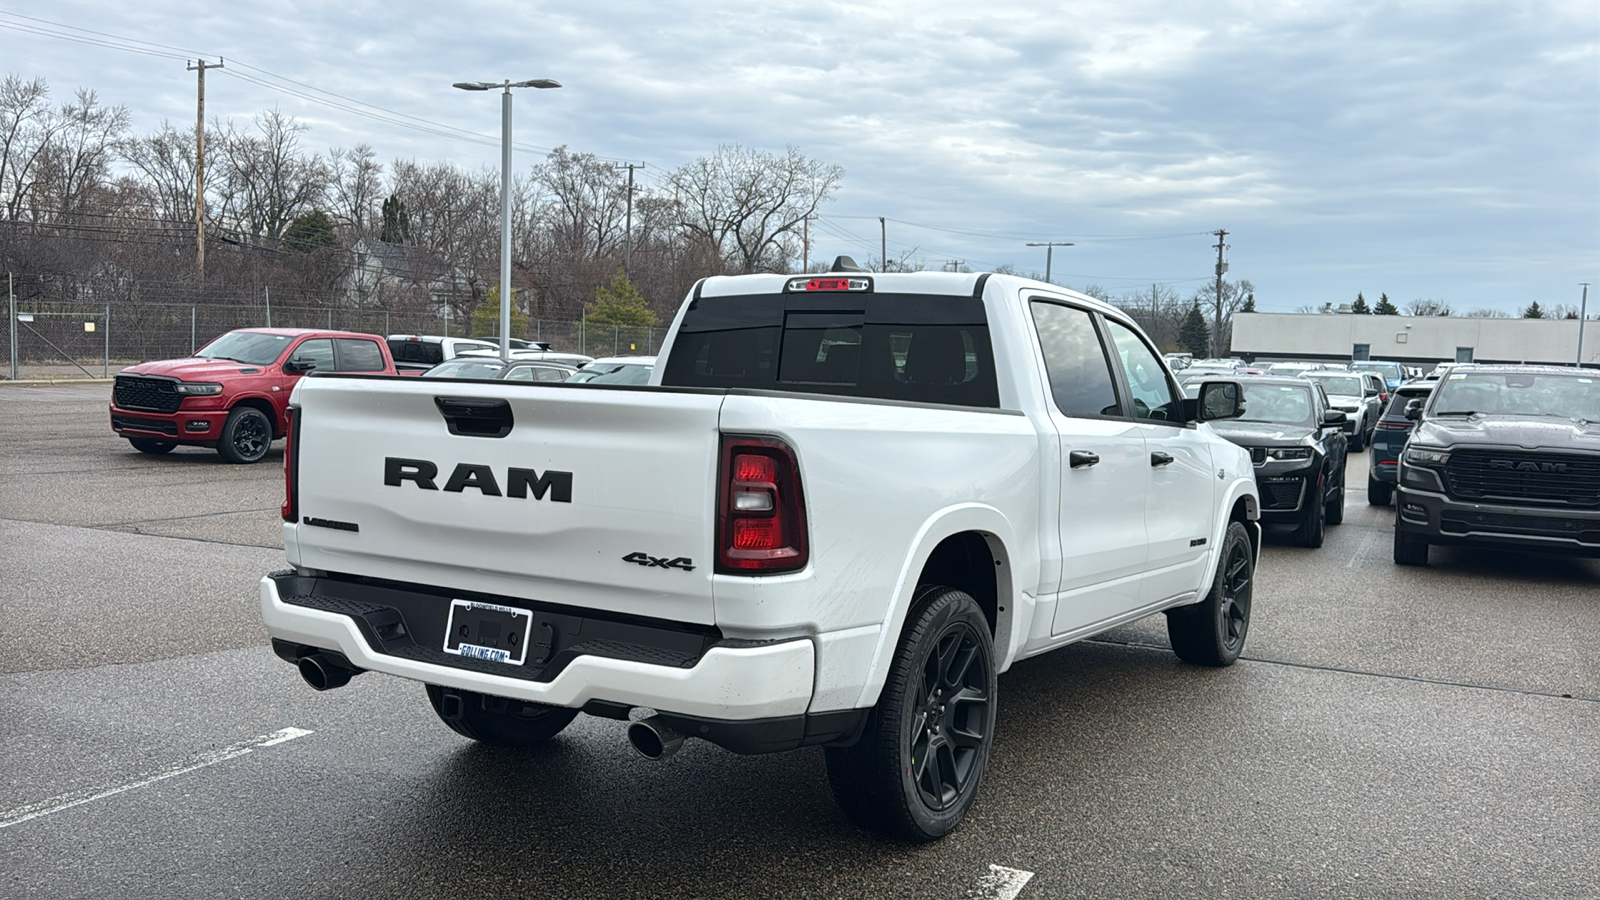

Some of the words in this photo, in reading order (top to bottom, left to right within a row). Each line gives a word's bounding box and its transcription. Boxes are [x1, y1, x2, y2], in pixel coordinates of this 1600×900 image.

[1490, 459, 1567, 472] RAM
[384, 456, 573, 503] RAM
[621, 552, 697, 572] 4x4
